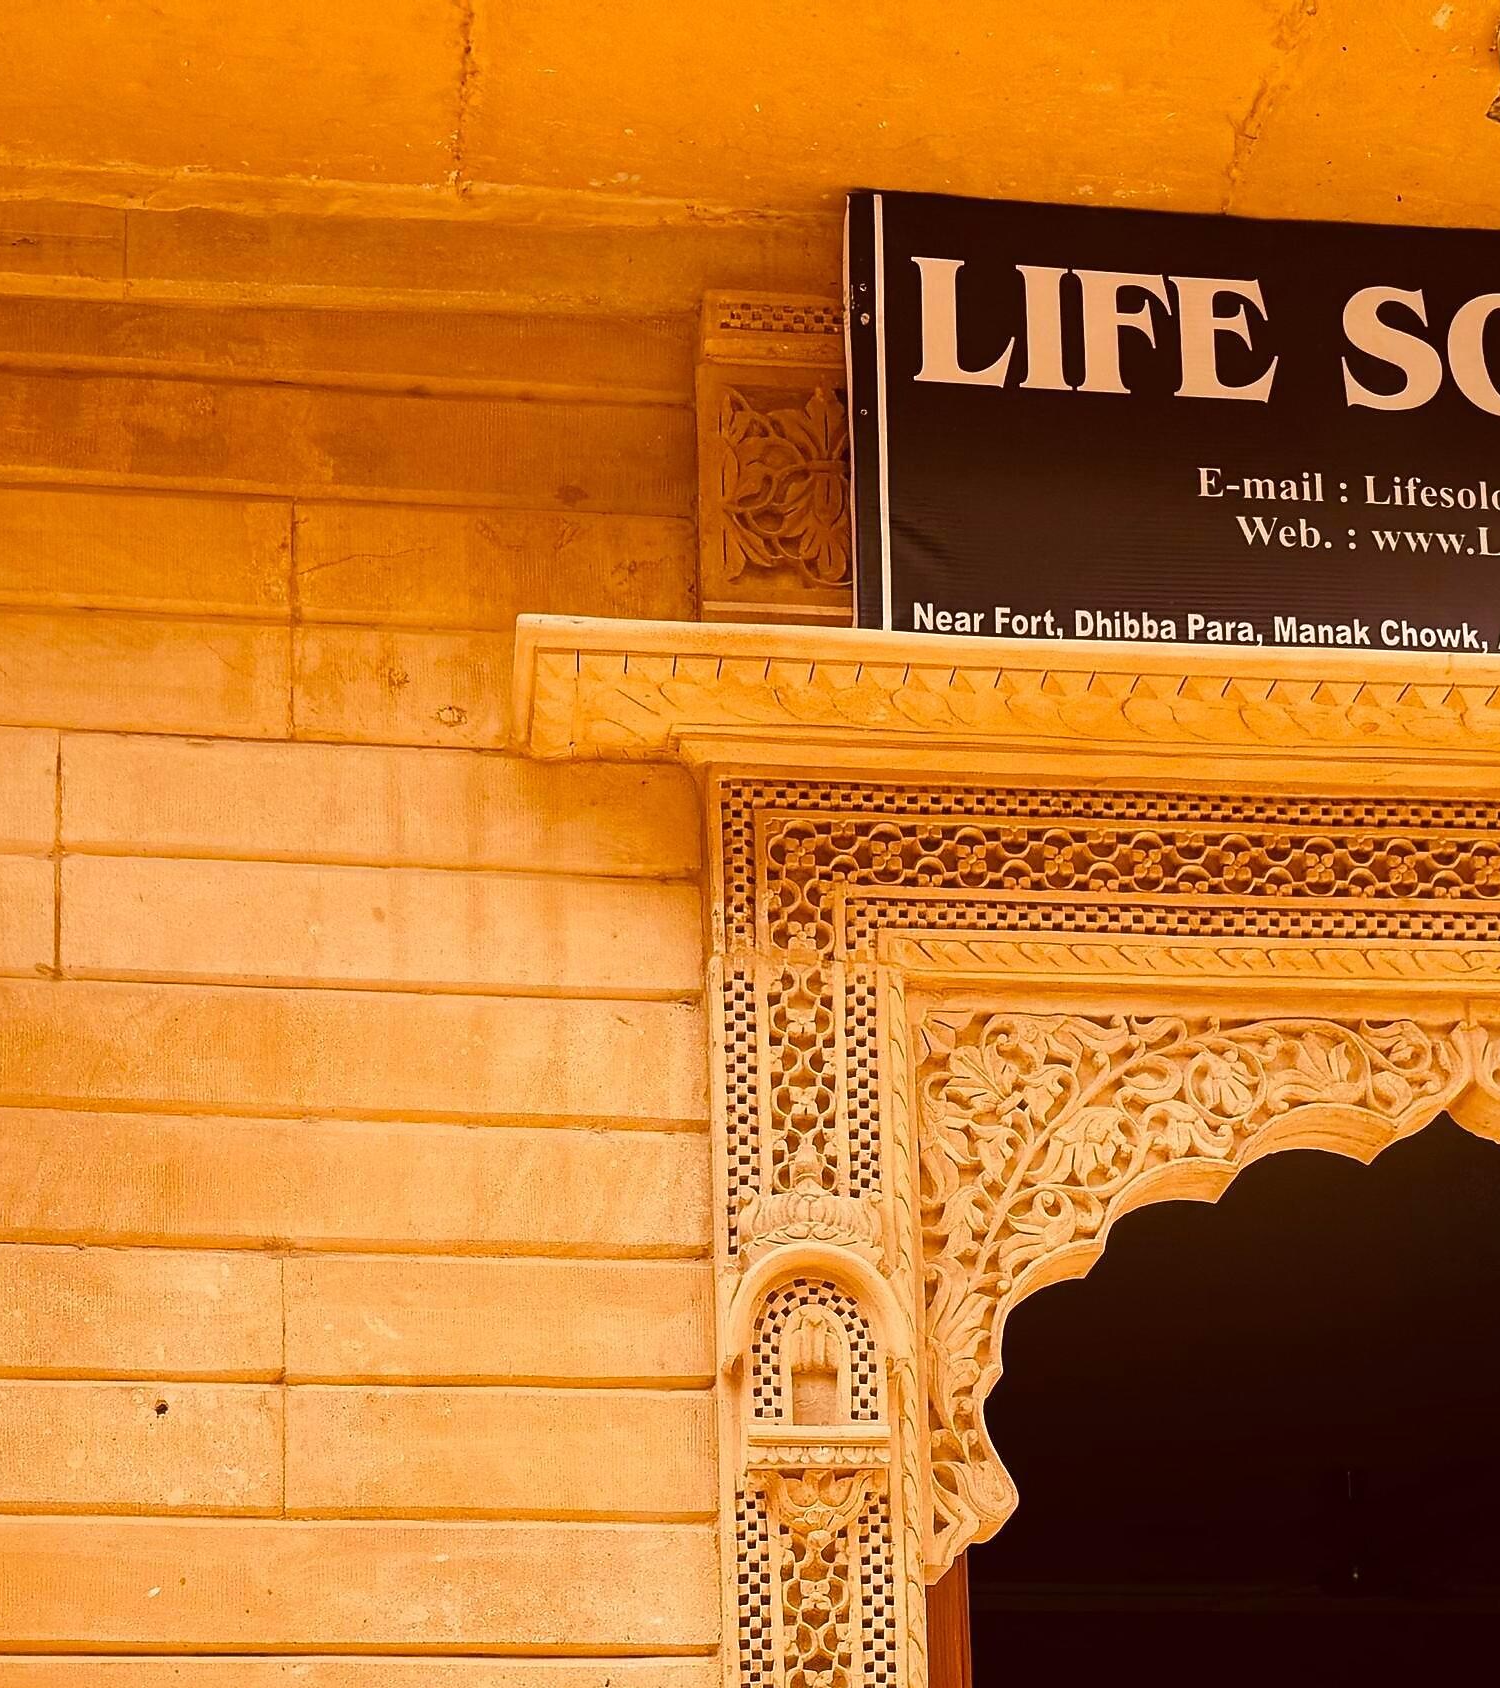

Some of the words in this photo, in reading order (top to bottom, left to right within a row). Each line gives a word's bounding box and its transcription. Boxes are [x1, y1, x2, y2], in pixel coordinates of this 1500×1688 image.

[910, 256, 1279, 404] LIFE
[1197, 467, 1325, 502] E-mail
[1235, 515, 1333, 549] Web.
[913, 601, 985, 633] Near
[994, 606, 1064, 640] Fort,
[1074, 609, 1177, 641] Dhibba
[1187, 613, 1264, 647] Para,
[1273, 615, 1371, 646] Manak
[1380, 618, 1488, 653] Chowk,
